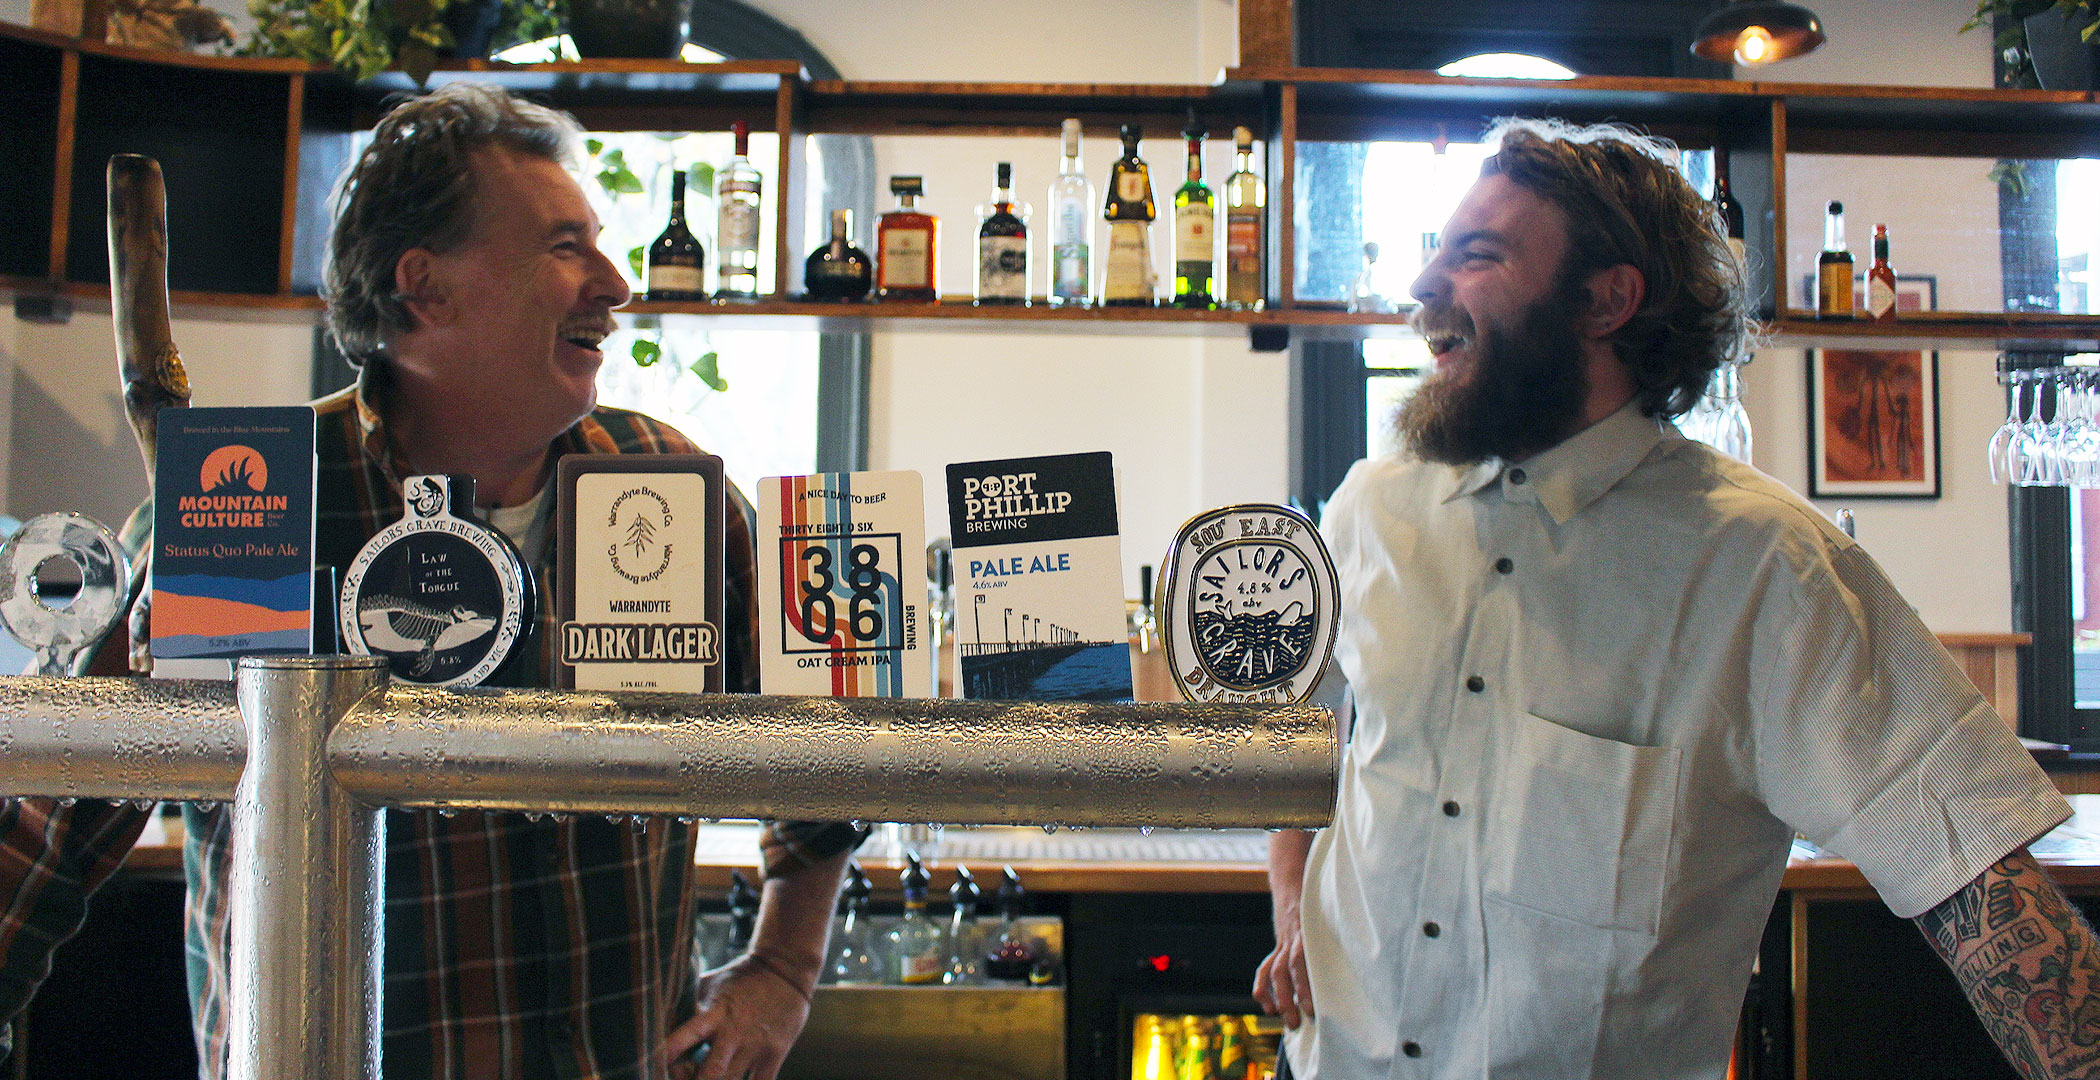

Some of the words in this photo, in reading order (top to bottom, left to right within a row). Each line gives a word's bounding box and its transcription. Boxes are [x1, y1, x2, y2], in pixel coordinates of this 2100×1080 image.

[798, 492, 806, 502] A
[807, 489, 829, 499] NICE
[830, 490, 848, 502] DAY
[850, 493, 863, 504] TO
[864, 492, 887, 504] BEER
[963, 472, 1037, 499] PORT
[178, 495, 288, 511] MOUNTAIN
[608, 488, 640, 527] Warrandyte
[641, 486, 670, 514] Brewing
[965, 491, 1072, 520] PHILLIP
[181, 512, 264, 528] CULTURE
[779, 523, 814, 535] THIRTY
[816, 523, 843, 534] EIGHT
[857, 521, 874, 532] SIX
[966, 517, 1028, 533] BREWING
[1238, 516, 1302, 539] EAST
[164, 543, 209, 556] Status
[212, 543, 242, 559] Quo
[245, 543, 274, 556] Pale
[277, 543, 299, 556] Ale
[359, 525, 403, 567] SAILORS
[406, 520, 446, 532] GRAVE
[449, 521, 497, 558] BREWING
[610, 556, 640, 585] Brewing
[640, 543, 673, 582] Warrandyte
[970, 557, 1024, 579] PALE
[1029, 553, 1071, 574] ALE
[1199, 547, 1305, 603] SAILORS
[609, 600, 671, 613] WARRANDYTE
[905, 604, 917, 650] BREWING
[489, 645, 505, 662] VIC
[568, 626, 633, 660] DARK
[637, 626, 713, 660] LAGER
[1202, 622, 1302, 679] GRAVE
[797, 658, 822, 669] OAT
[825, 656, 868, 667] CREAM
[871, 655, 892, 666] IPA
